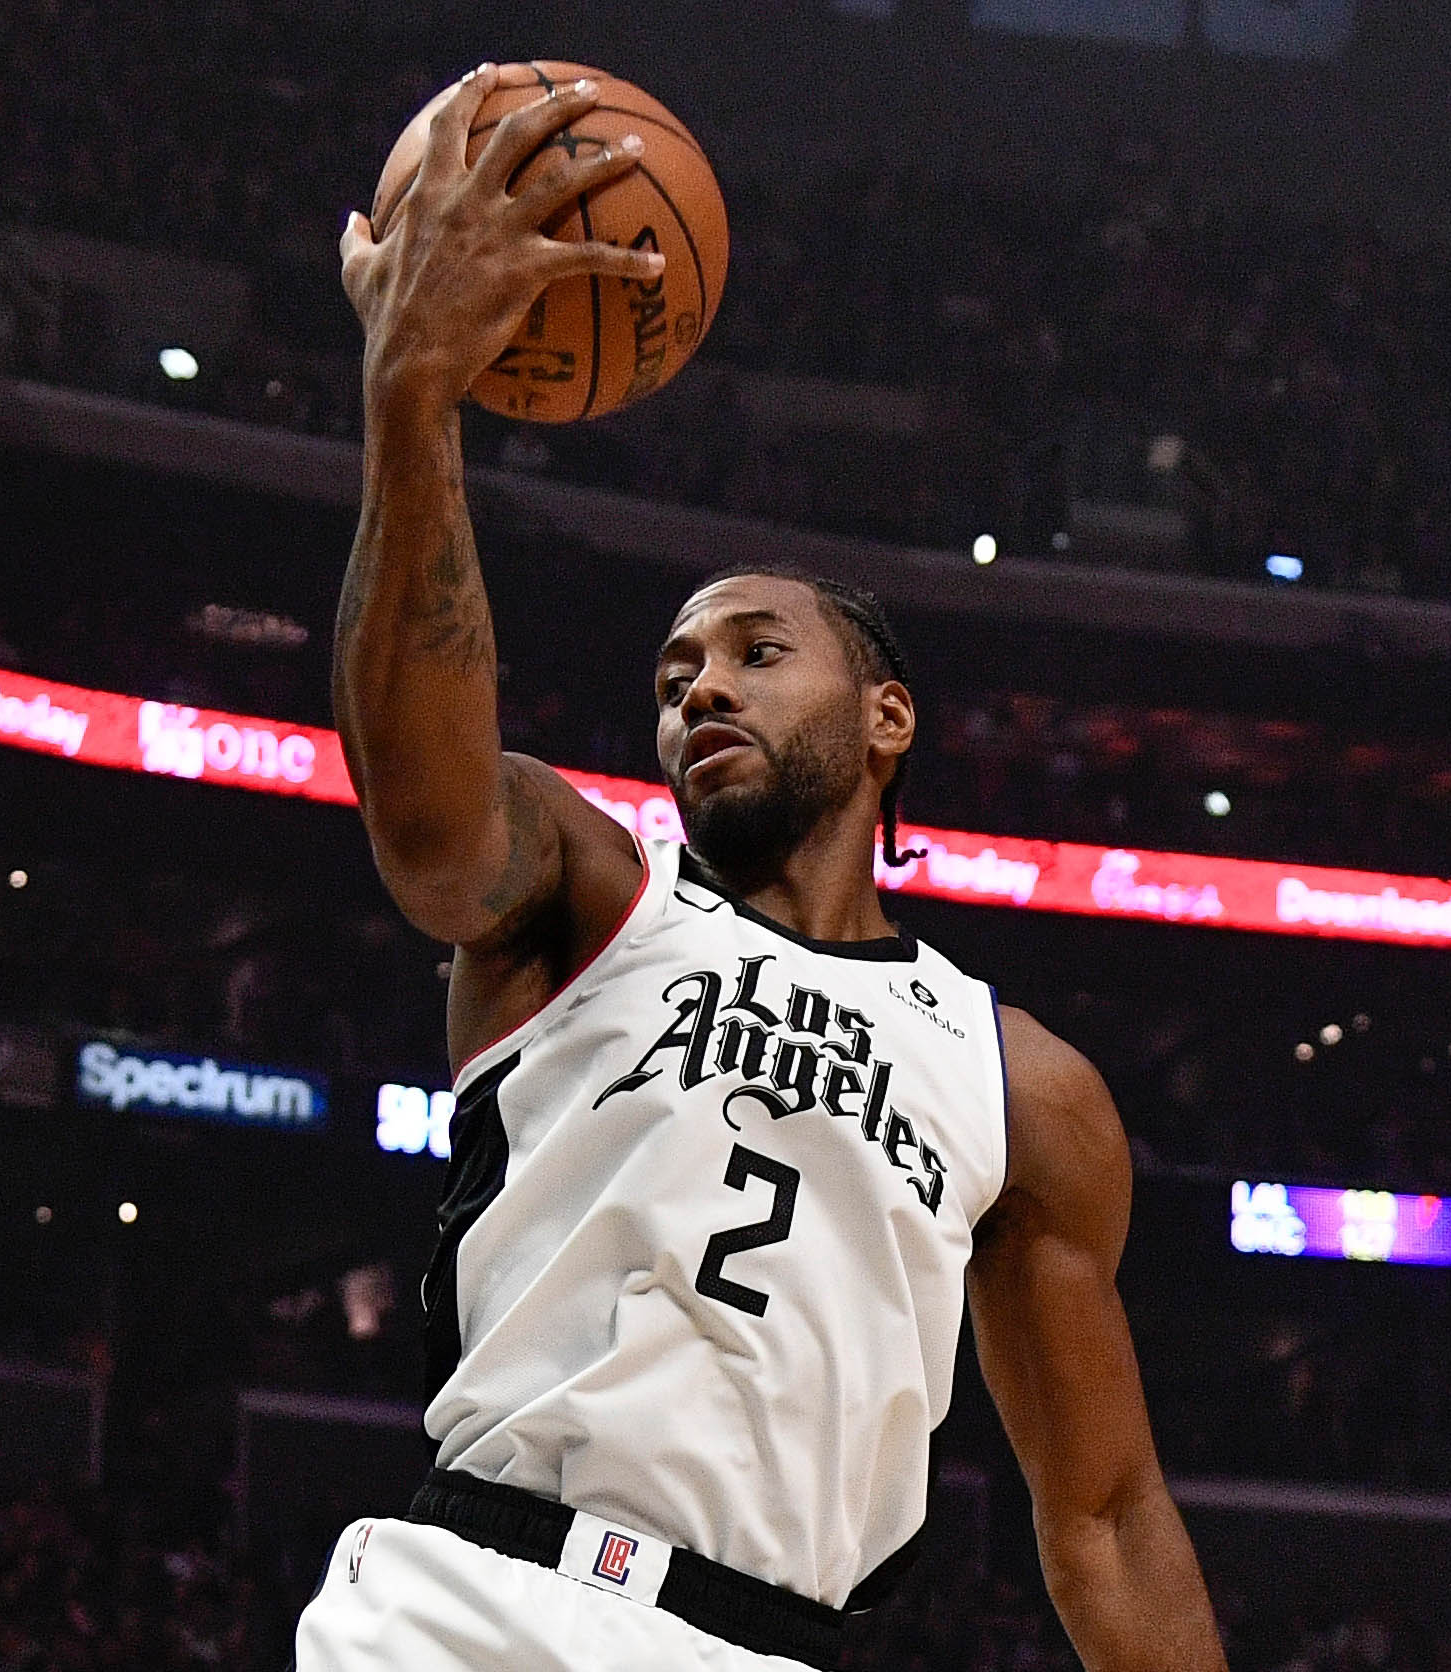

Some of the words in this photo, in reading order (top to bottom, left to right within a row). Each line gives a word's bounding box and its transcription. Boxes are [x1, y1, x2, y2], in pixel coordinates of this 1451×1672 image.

[721, 955, 875, 1068] Los
[888, 978, 966, 1040] bumble
[79, 1041, 317, 1122] Spectrum
[592, 970, 948, 1218] Angeles
[695, 1143, 801, 1318] 2
